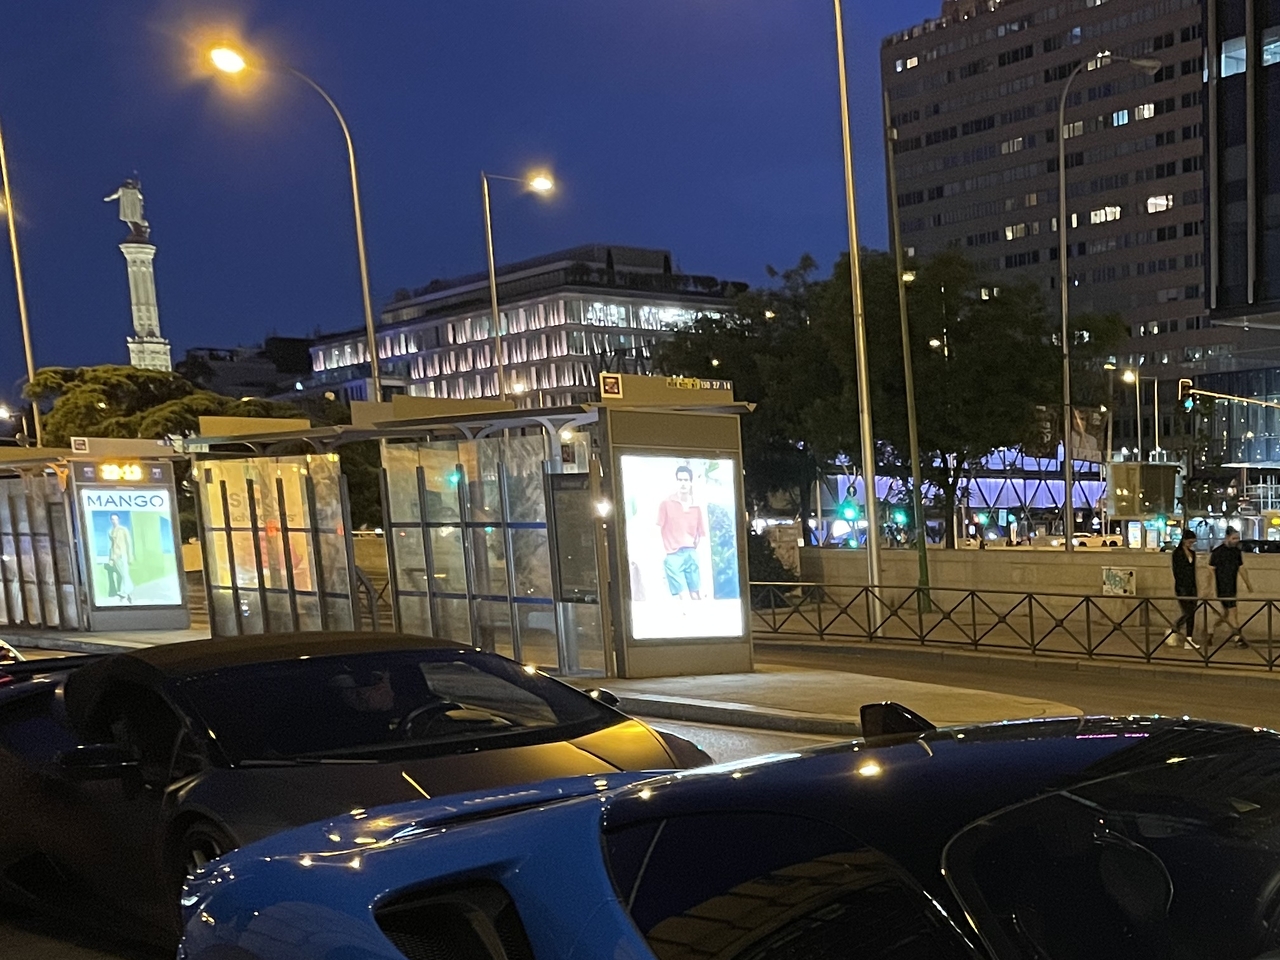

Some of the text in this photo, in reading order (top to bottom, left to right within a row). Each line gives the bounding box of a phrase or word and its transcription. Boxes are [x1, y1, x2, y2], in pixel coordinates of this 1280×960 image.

[700, 381, 711, 389] 150
[712, 381, 720, 389] 27
[87, 495, 164, 508] MANGO
